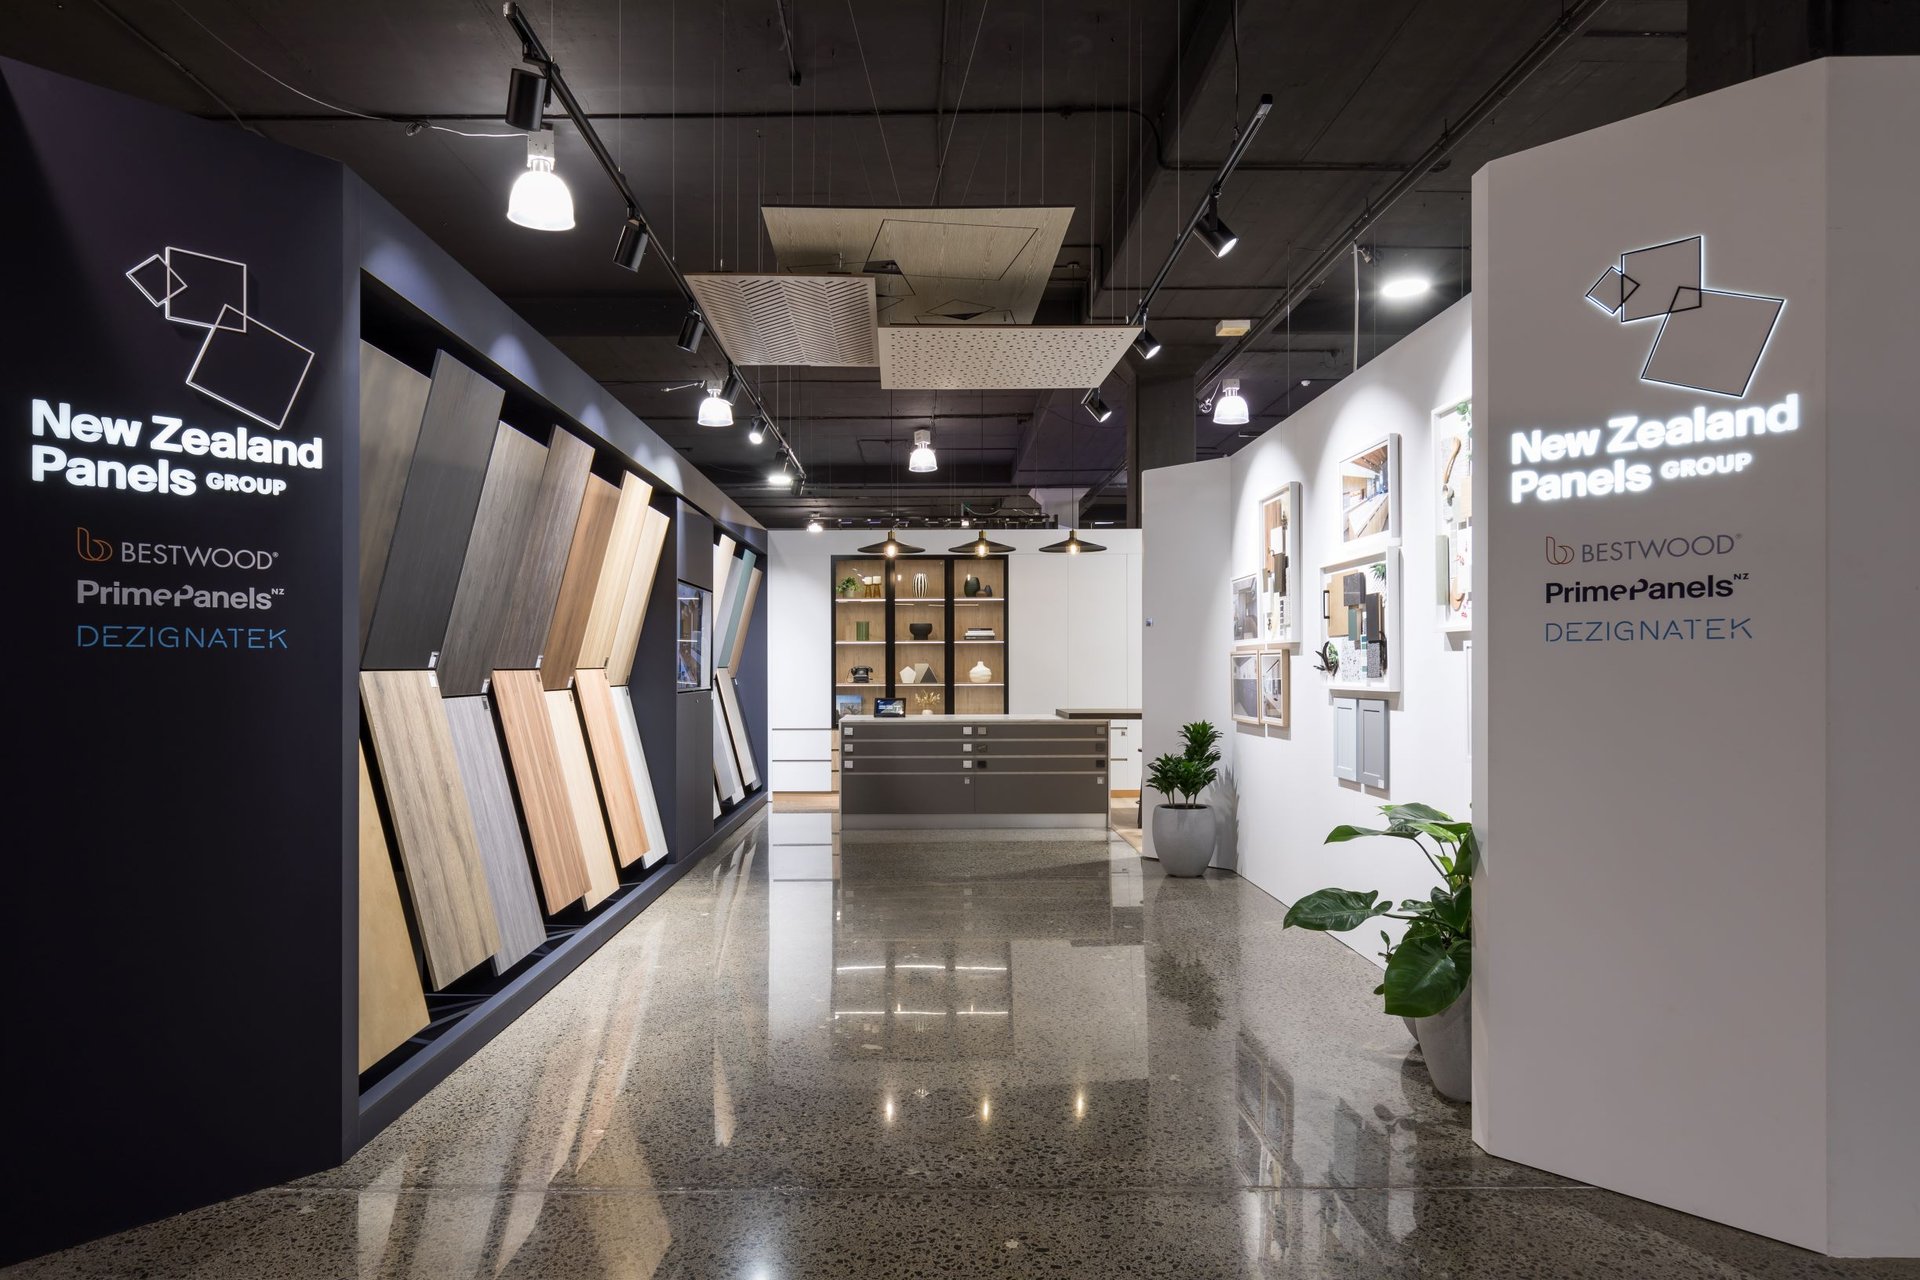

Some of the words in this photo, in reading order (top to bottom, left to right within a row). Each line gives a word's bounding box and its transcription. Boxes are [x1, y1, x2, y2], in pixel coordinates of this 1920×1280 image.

[31, 398, 143, 448] New
[150, 414, 323, 470] Zealand
[1511, 429, 1601, 465] New
[1607, 393, 1799, 454] Zealand
[31, 445, 197, 497] Panels
[206, 472, 288, 496] GROUP
[1511, 459, 1653, 504] Panels
[1660, 452, 1753, 480] GROUP
[77, 625, 289, 649] DEZIGNATEK
[1545, 617, 1753, 643] DEZIGNATEK
